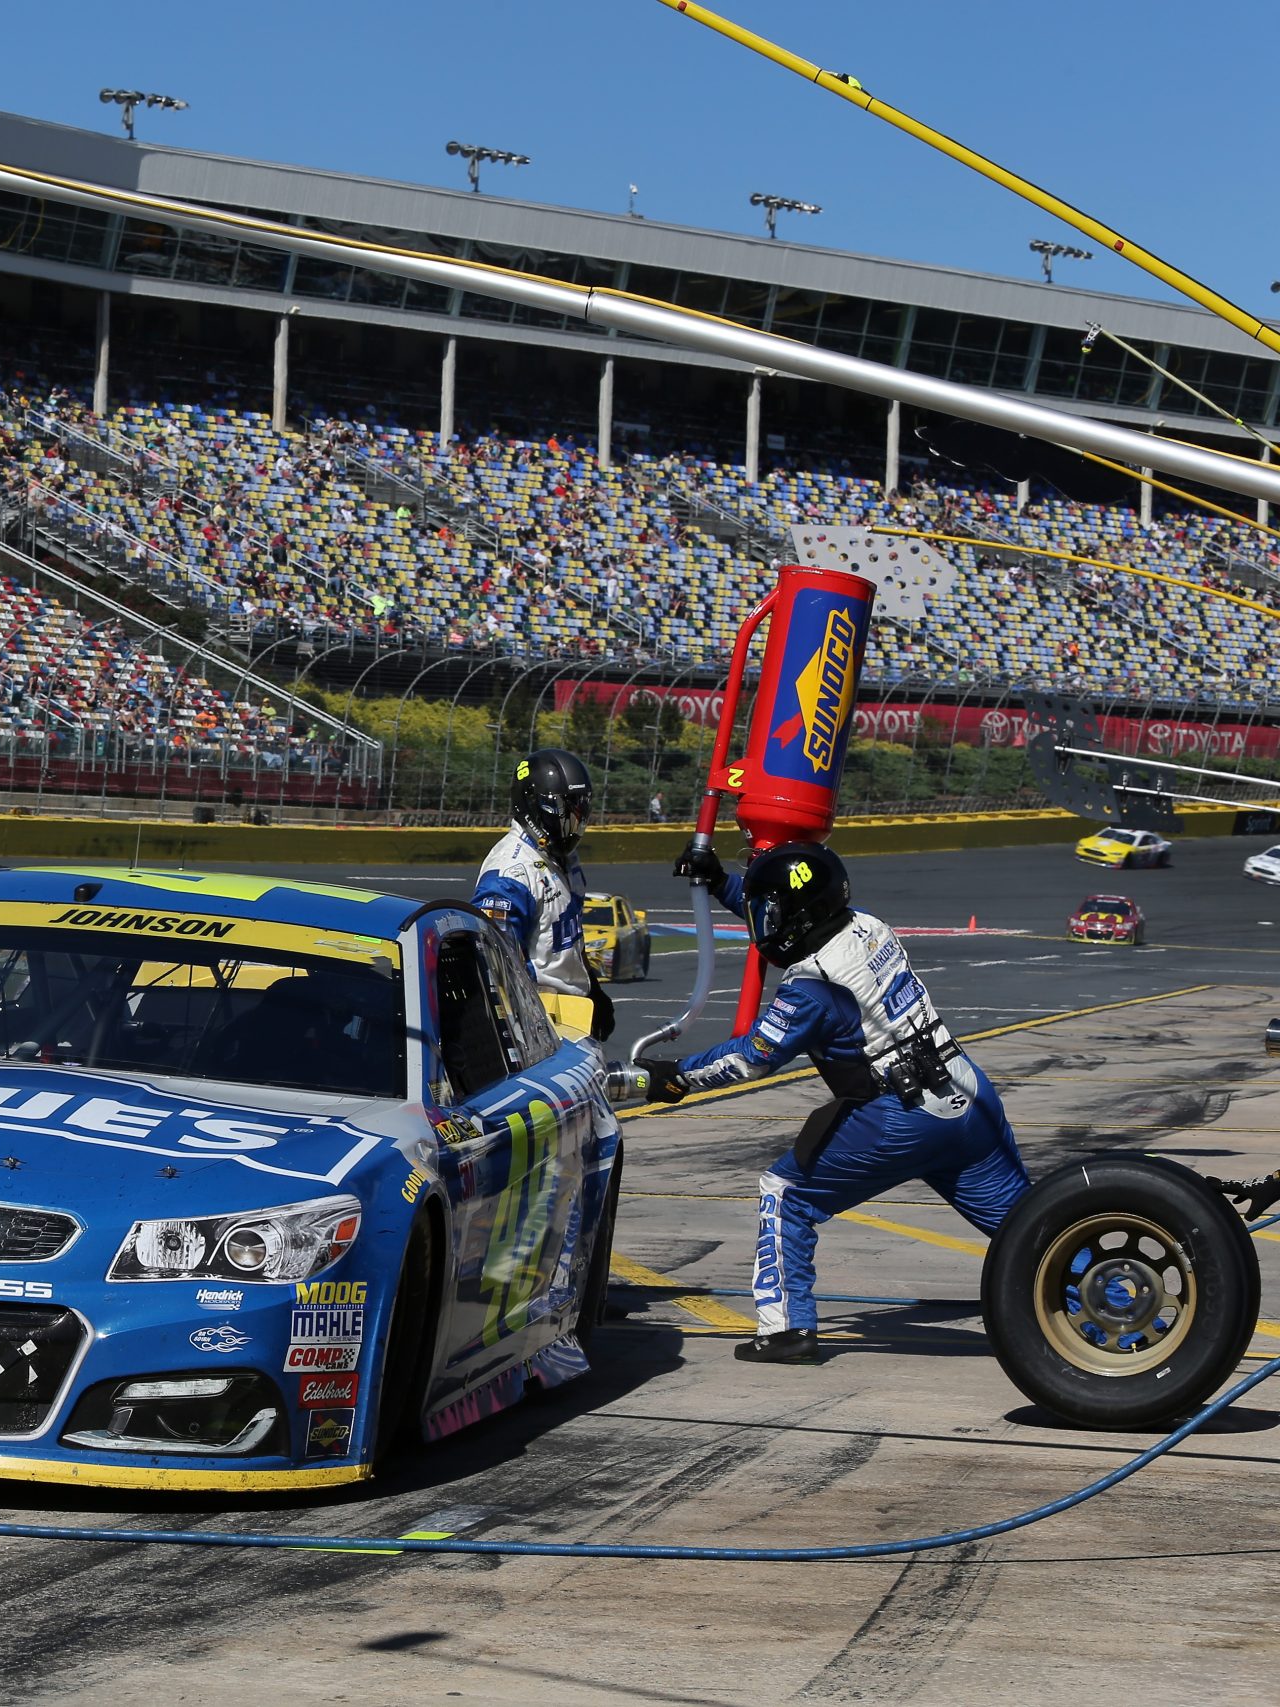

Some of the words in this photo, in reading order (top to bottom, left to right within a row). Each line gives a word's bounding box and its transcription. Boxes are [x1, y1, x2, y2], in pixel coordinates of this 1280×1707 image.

[807, 612, 855, 771] SUNOCO
[854, 710, 922, 734] OYOTA
[1175, 727, 1246, 754] TOYOTA
[516, 760, 530, 781] 48
[727, 767, 745, 788] 2
[789, 861, 813, 890] 48
[49, 908, 236, 938] JOHNSON
[867, 939, 898, 975] HARDER
[636, 1075, 646, 1089] 48
[196, 1289, 244, 1301] Hendrick
[295, 1281, 368, 1305] MOOG
[293, 1310, 363, 1337] MAHLE
[288, 1347, 343, 1368] COMP
[325, 1361, 350, 1370] CAMS
[302, 1380, 353, 1402] Edelbrock
[311, 1427, 347, 1440] SUNOCO
